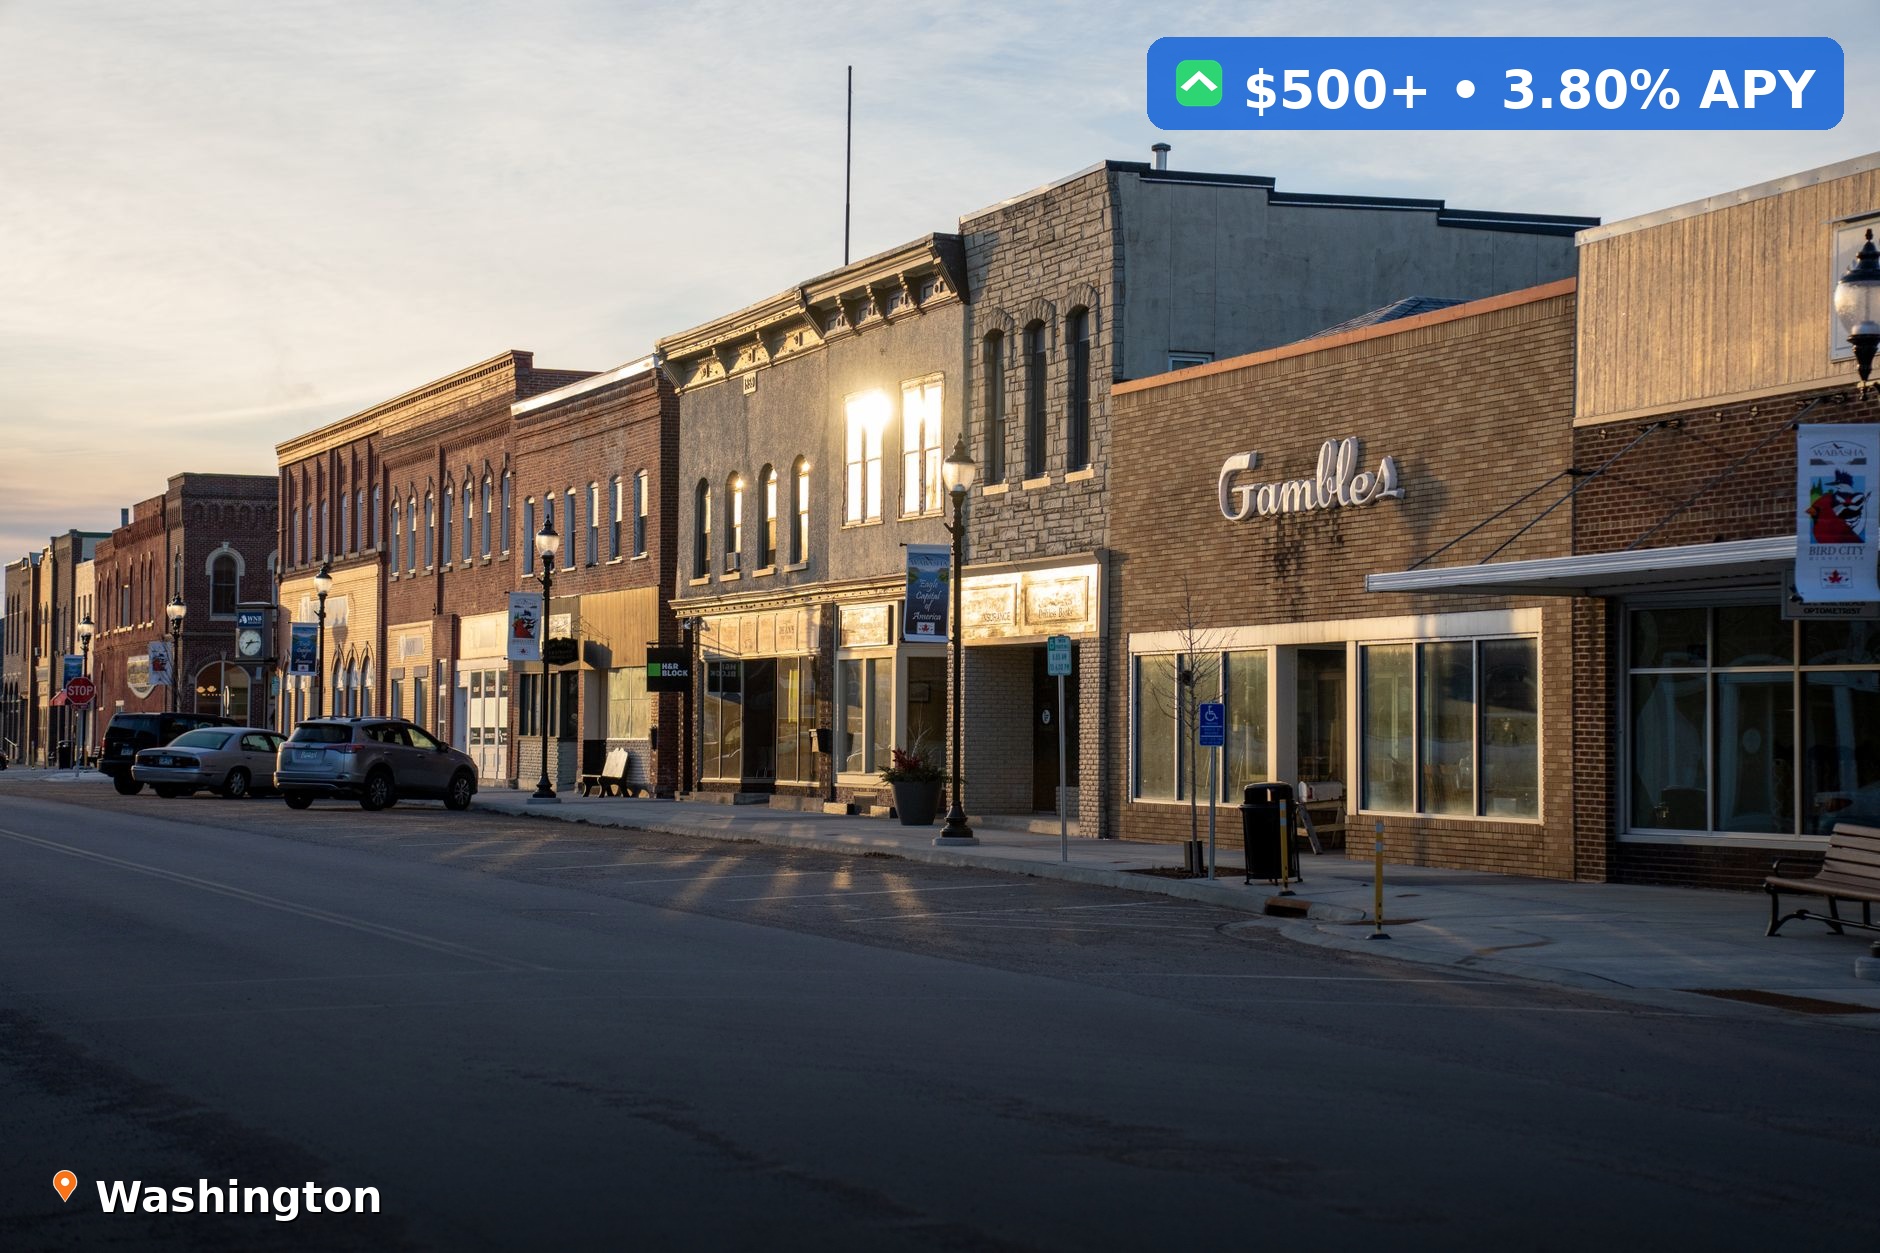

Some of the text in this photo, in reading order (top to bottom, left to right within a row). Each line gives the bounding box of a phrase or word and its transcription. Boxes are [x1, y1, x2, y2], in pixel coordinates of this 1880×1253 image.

[1813, 448, 1865, 457] WABASHA
[1218, 436, 1405, 521] Gambles
[1809, 545, 1865, 556] BIRD CITY
[920, 579, 938, 592] Eagle
[915, 591, 941, 602] Capital
[924, 602, 932, 611] of
[1803, 607, 1862, 615] OPTOMETRIST
[912, 612, 942, 620] America
[982, 611, 1011, 621] NSURANCE
[68, 685, 94, 696] STOP
